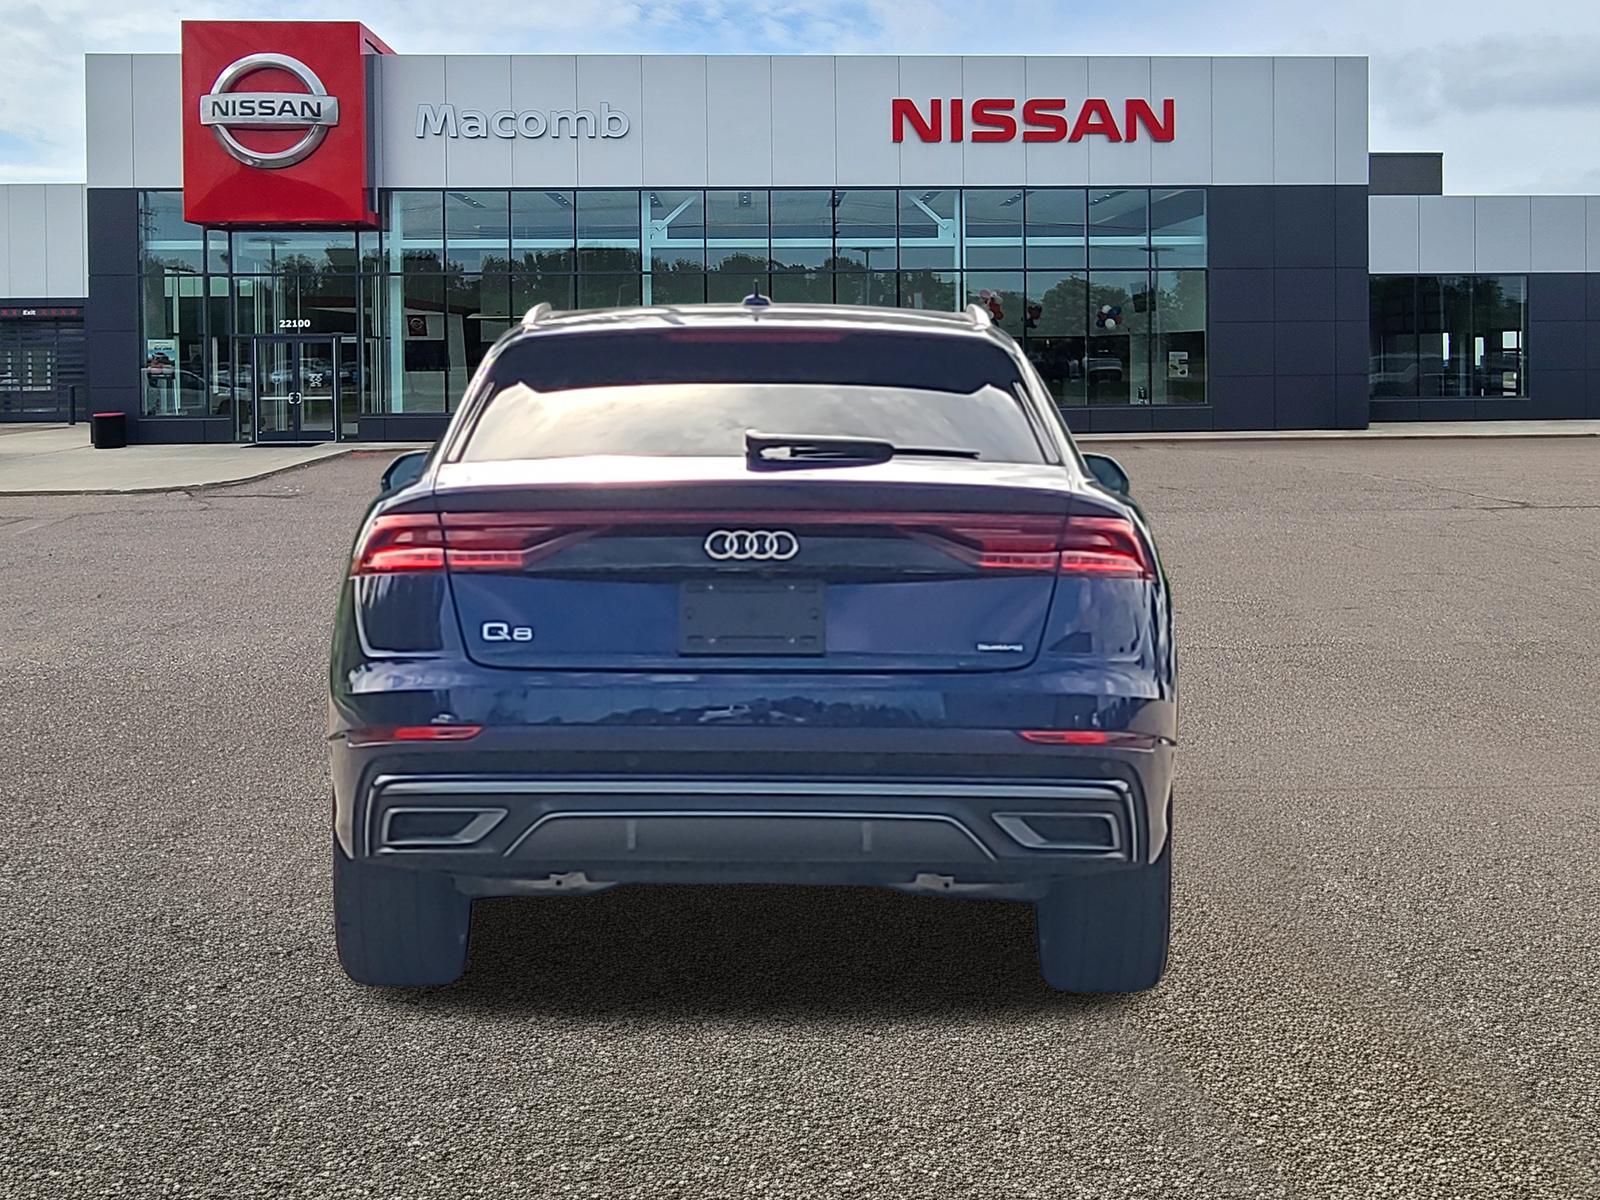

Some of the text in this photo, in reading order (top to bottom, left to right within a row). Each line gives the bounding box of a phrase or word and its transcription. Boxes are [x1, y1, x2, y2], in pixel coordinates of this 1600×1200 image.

[211, 100, 322, 118] NISSAN
[415, 101, 630, 139] Macomb
[891, 98, 1176, 143] NISSAN
[279, 319, 311, 328] 22100
[482, 622, 533, 641] Q8
